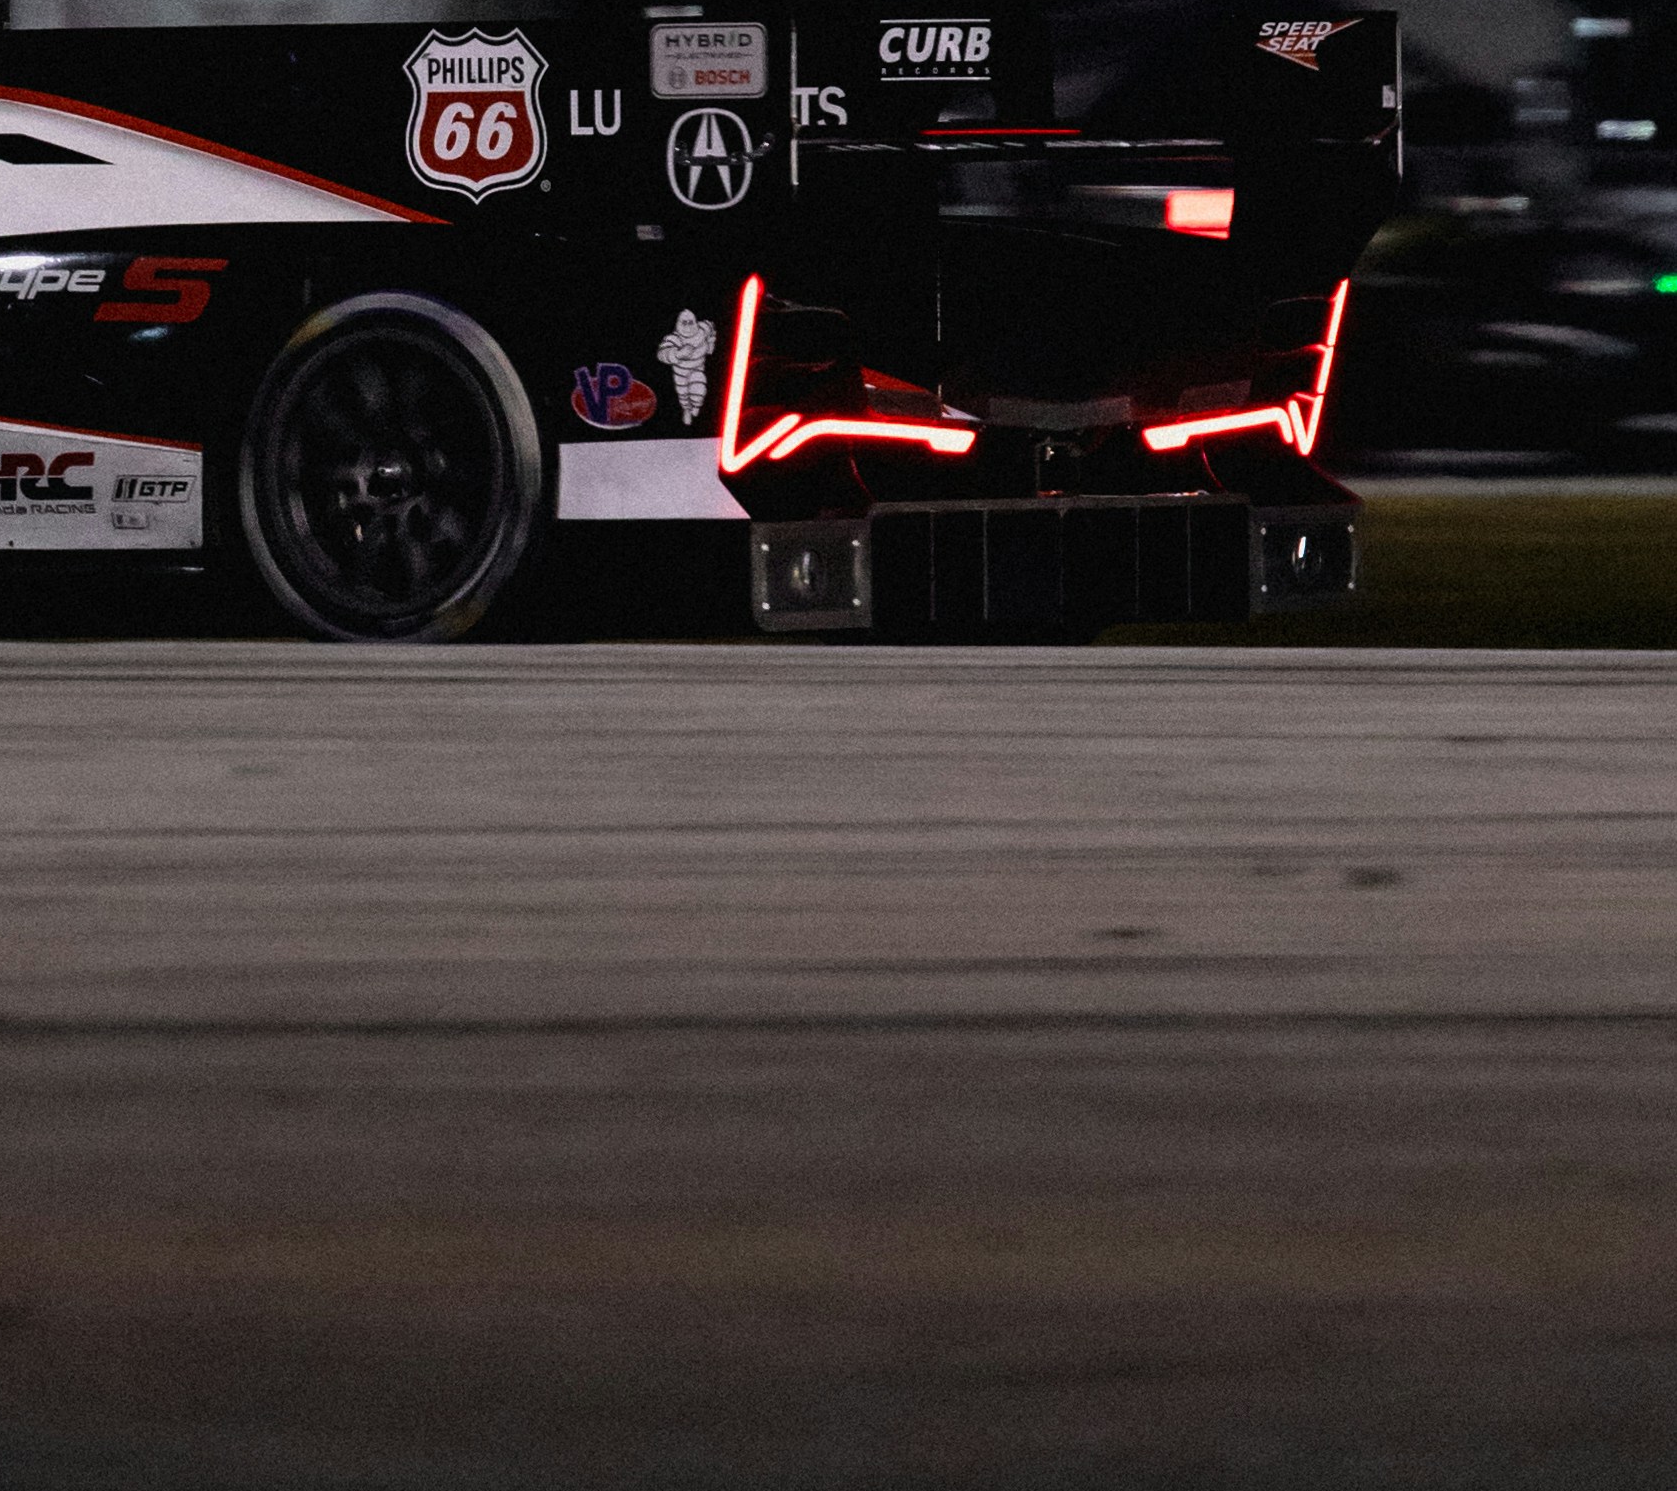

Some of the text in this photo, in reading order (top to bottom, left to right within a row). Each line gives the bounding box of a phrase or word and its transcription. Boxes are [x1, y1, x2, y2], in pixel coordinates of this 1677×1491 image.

[1258, 21, 1333, 36] SPEED
[665, 32, 753, 48] HYBRID
[878, 26, 992, 64] CURB
[1268, 36, 1327, 52] SEAT
[427, 56, 525, 85] PHILLIPS
[694, 69, 751, 86] BOSCH
[881, 66, 990, 75] RECORDS
[433, 101, 518, 161] 66
[93, 256, 229, 323] S
[139, 481, 188, 497] GTP
[30, 503, 96, 515] RACING
